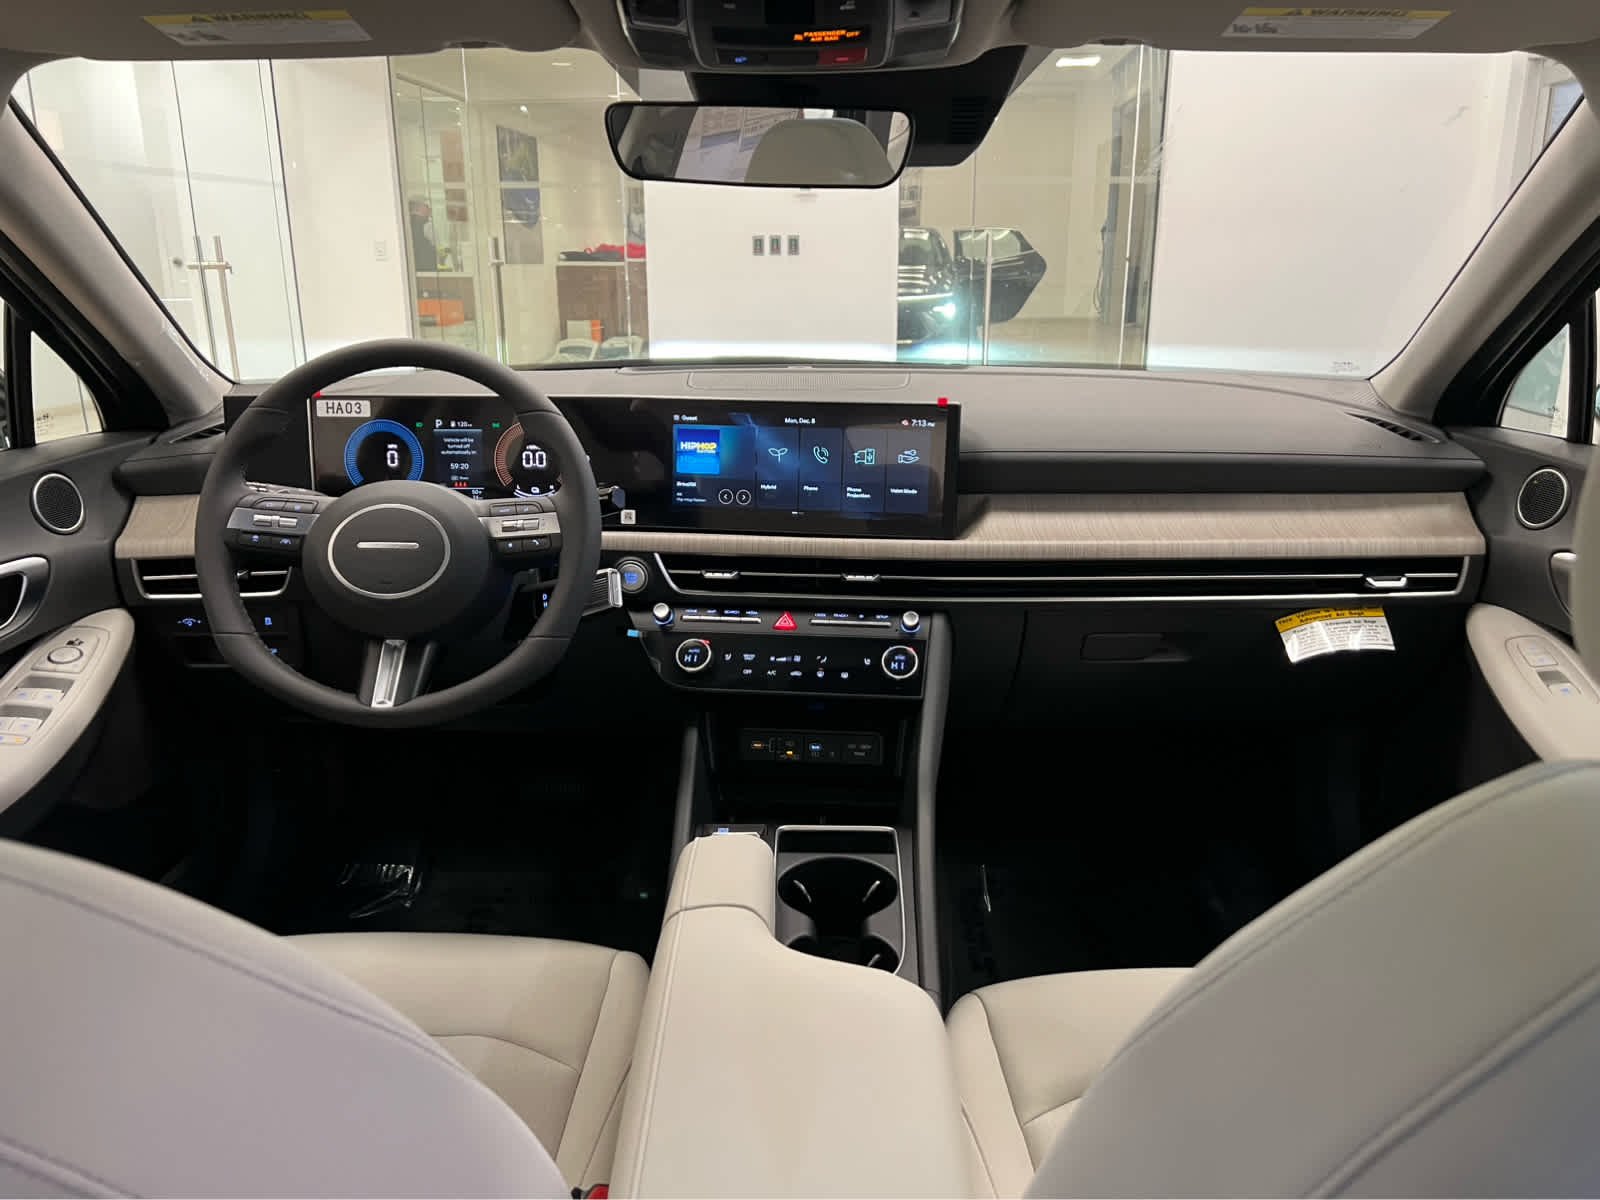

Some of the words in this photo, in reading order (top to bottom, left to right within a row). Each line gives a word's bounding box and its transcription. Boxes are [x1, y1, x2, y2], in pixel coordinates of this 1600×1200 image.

[803, 29, 847, 38] PASSENGER
[326, 402, 362, 414] HA03
[435, 419, 443, 428] P
[911, 419, 927, 427] 7:13
[386, 450, 399, 467] 0
[522, 451, 546, 468] 0.0
